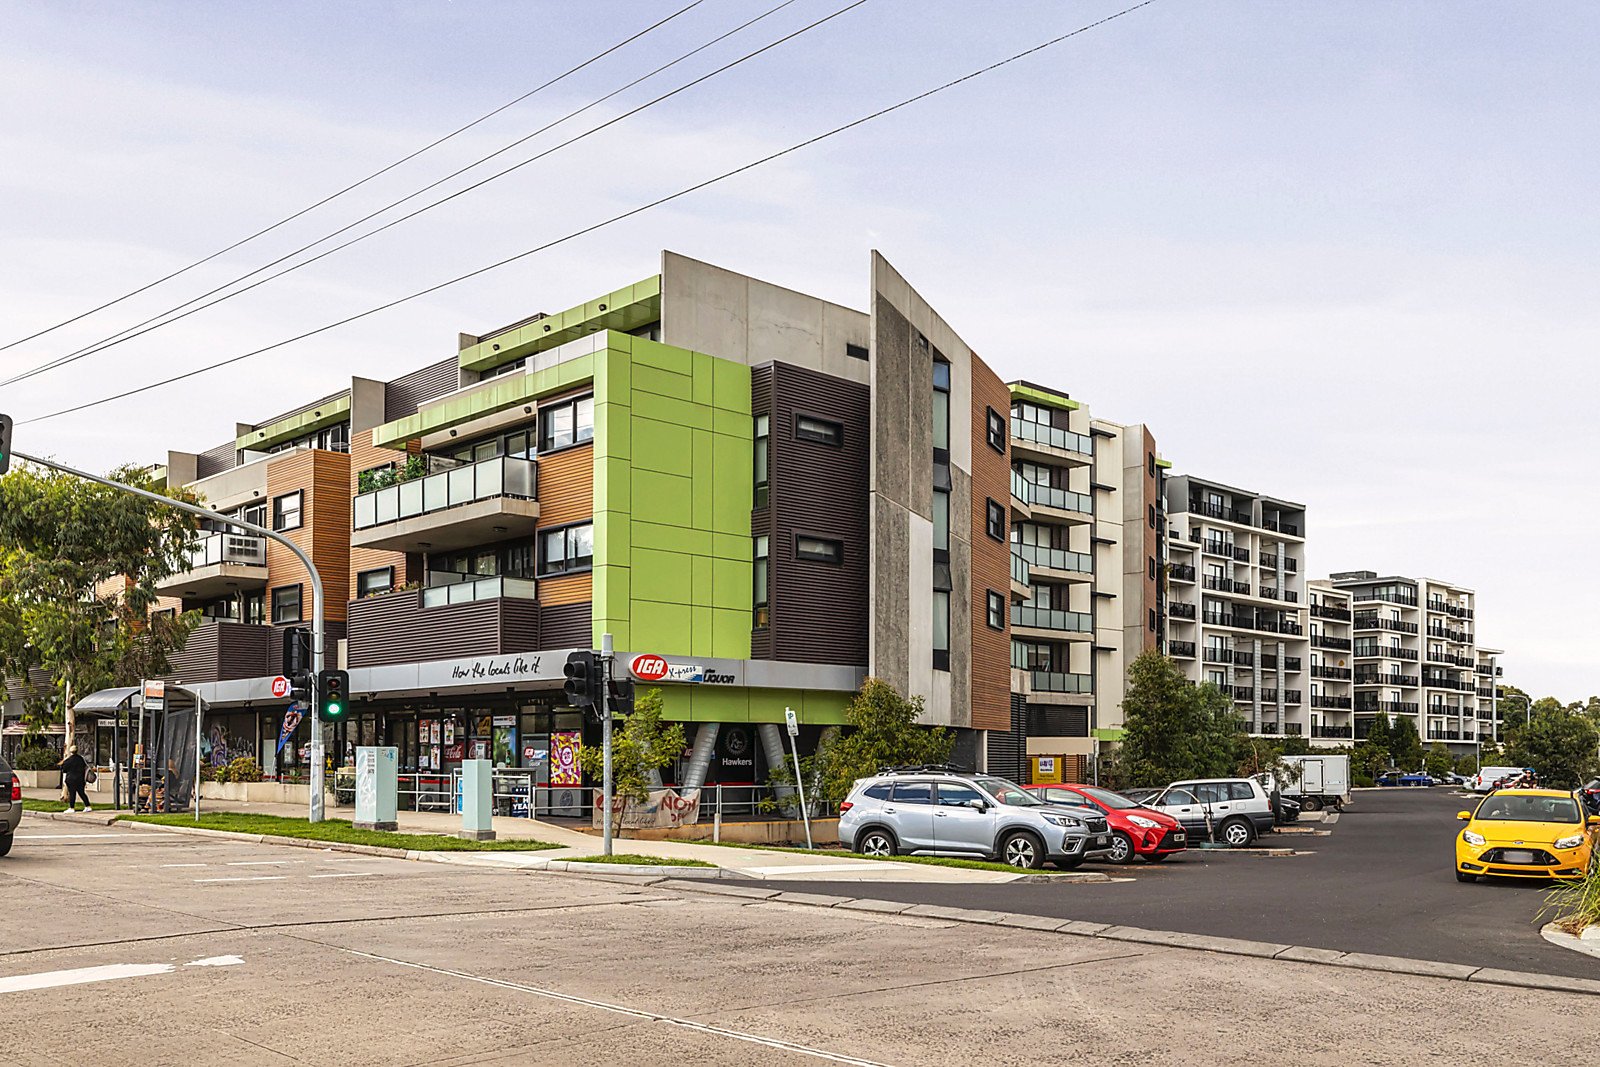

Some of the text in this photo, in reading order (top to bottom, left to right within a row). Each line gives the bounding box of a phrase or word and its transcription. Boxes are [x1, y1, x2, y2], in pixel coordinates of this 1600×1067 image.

[452, 666, 470, 678] How
[472, 662, 485, 678] the
[488, 660, 511, 676] locals
[513, 658, 528, 674] like
[636, 659, 664, 675] IGA
[722, 758, 752, 766] Hawkers
